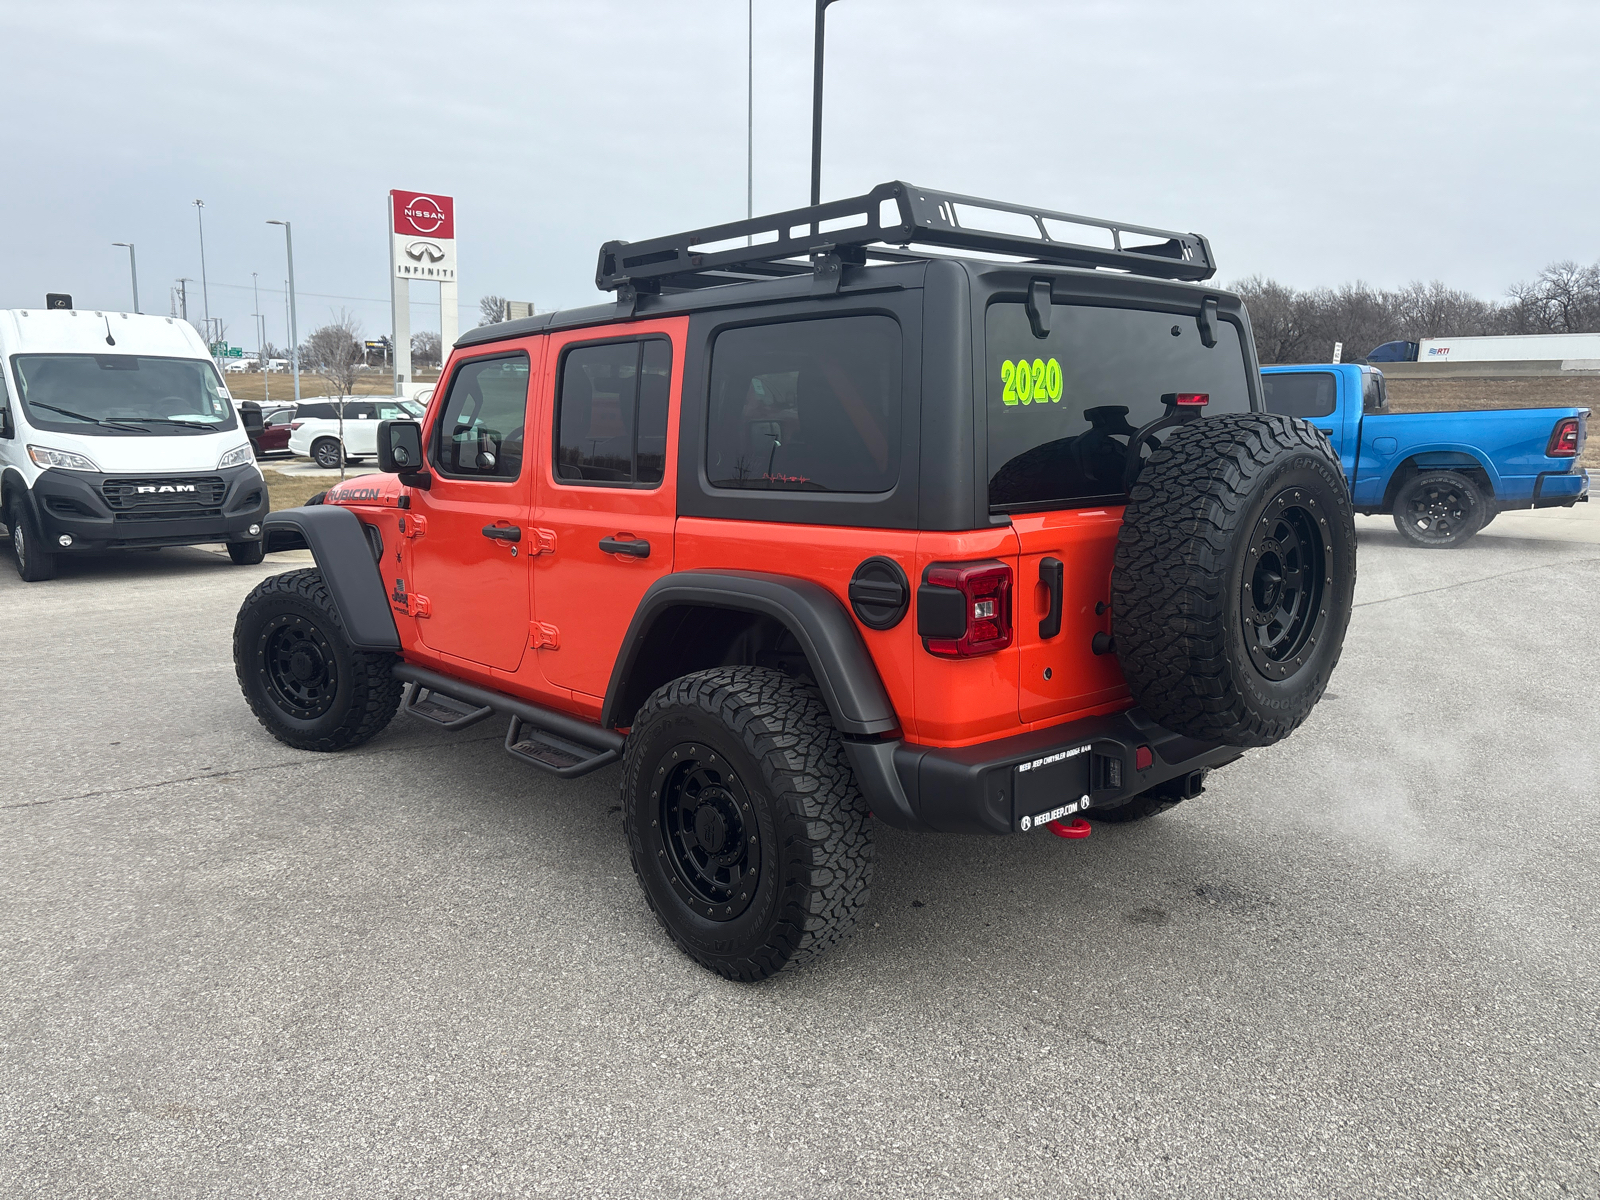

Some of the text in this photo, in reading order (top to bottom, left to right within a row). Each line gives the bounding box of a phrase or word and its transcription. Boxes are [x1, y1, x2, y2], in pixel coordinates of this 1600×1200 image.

[404, 208, 445, 220] NISSAN
[398, 265, 454, 278] INFINITI
[1436, 347, 1450, 355] RTI
[1001, 358, 1063, 406] 2020
[137, 484, 195, 494] RAM
[327, 488, 380, 501] RUBICON
[1019, 744, 1092, 773] REED JEEP CHRYSLER DODGE RAM
[1034, 802, 1078, 827] REEDJEEP.COM
